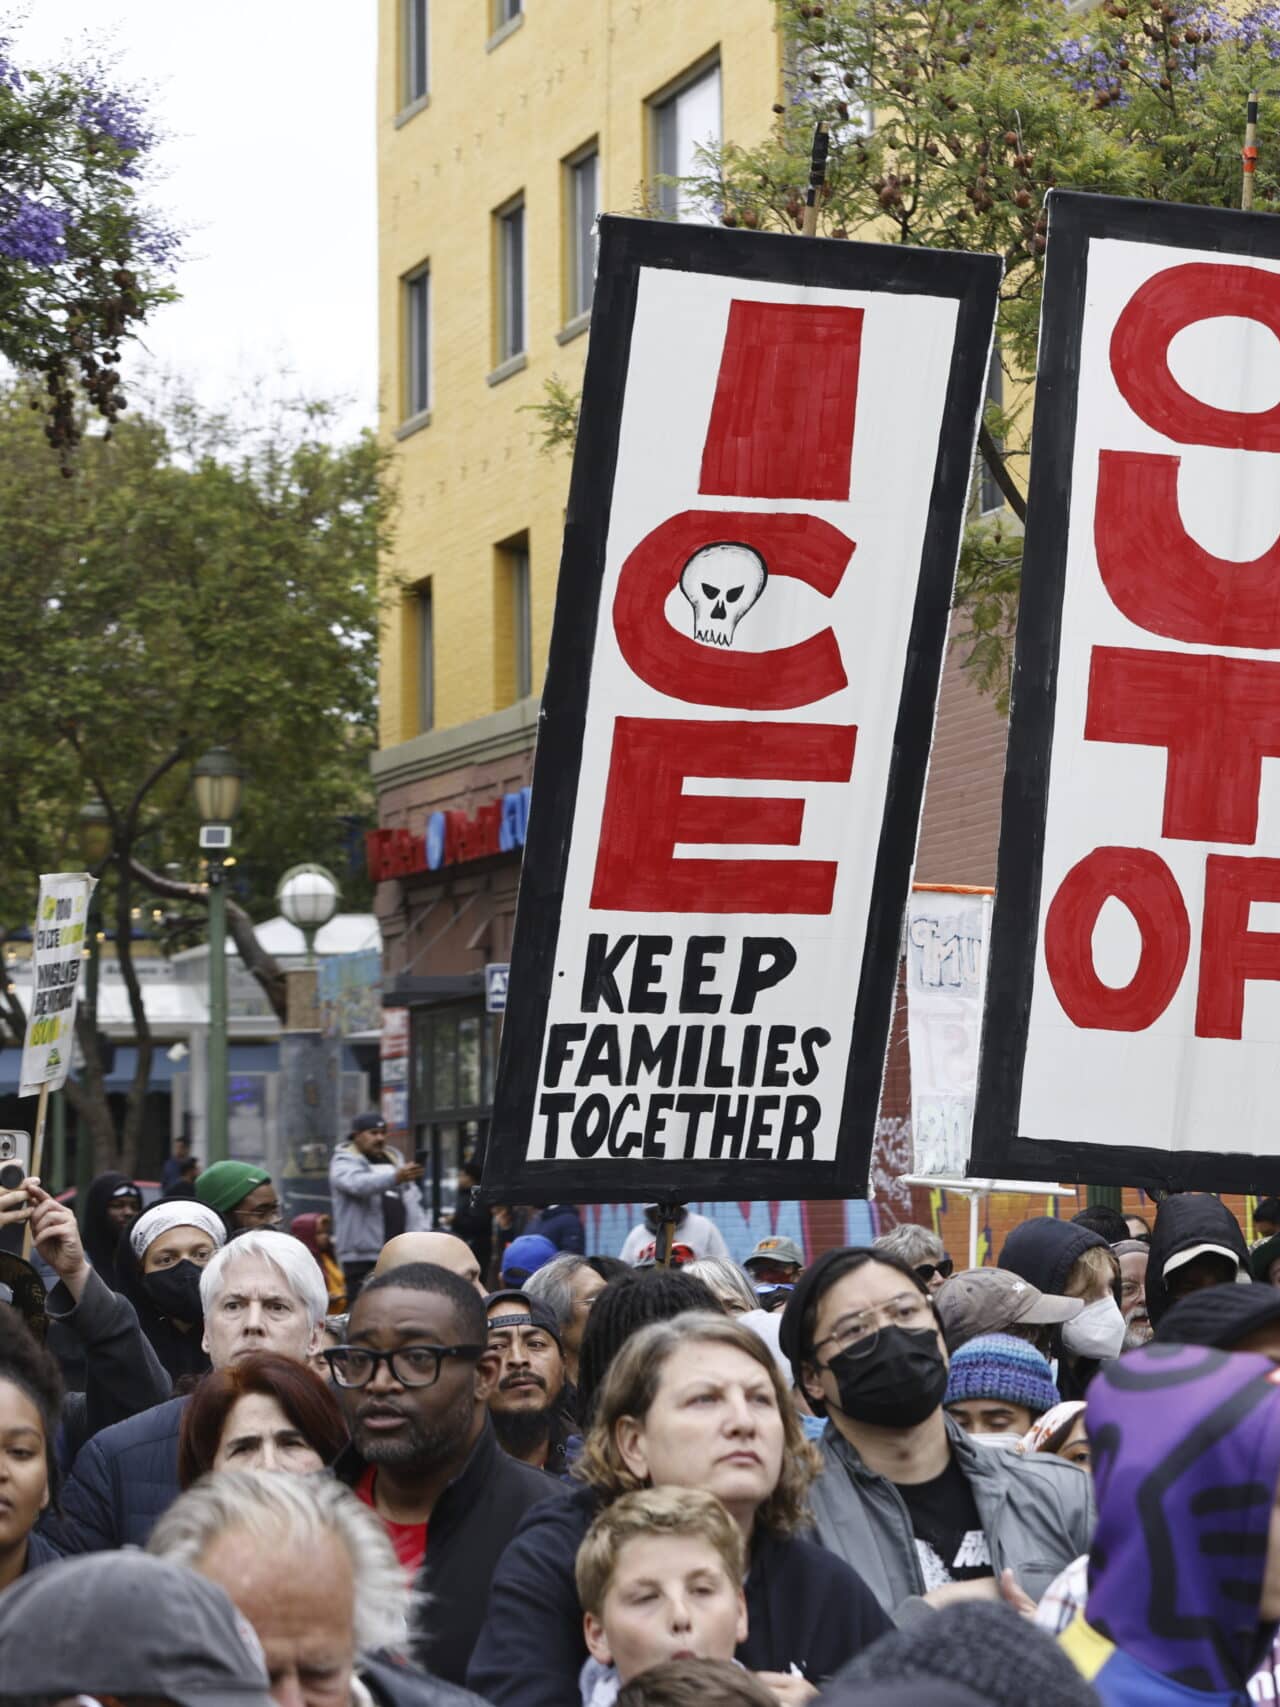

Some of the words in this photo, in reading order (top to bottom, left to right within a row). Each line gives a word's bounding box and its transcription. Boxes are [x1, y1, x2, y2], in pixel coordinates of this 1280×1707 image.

[589, 299, 864, 915] ICE
[580, 933, 797, 1015] KEEP
[543, 1022, 832, 1089] FAMILIES
[539, 1093, 822, 1161] TOGETHER
